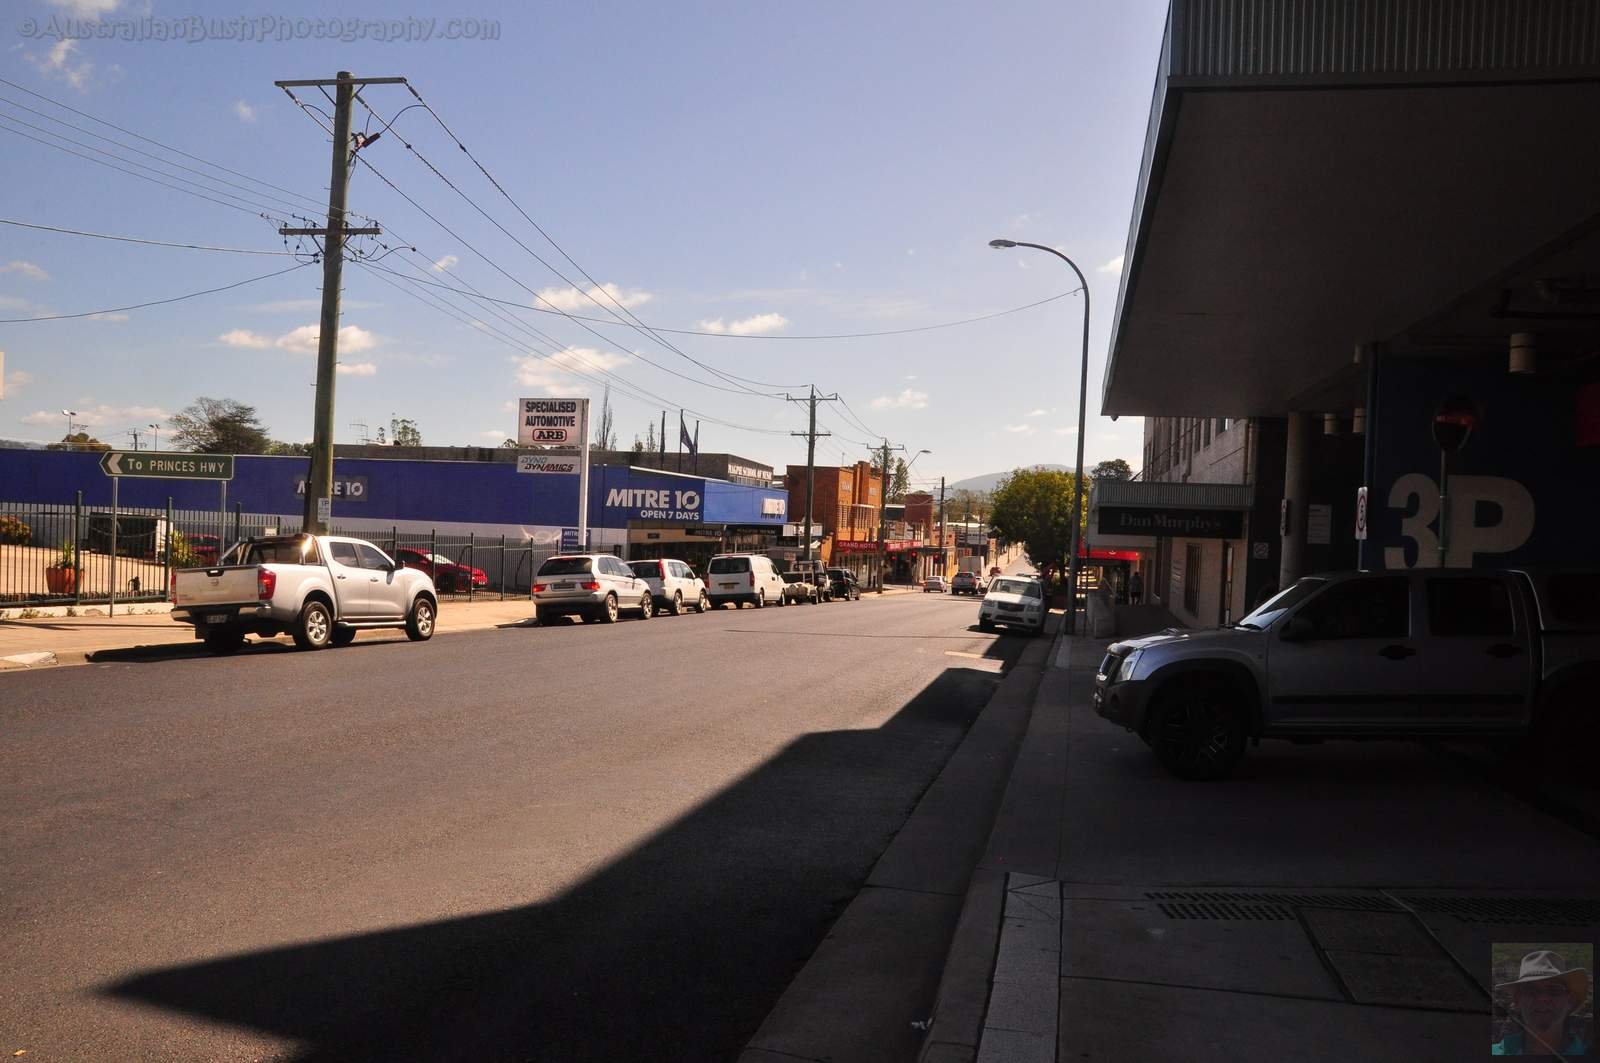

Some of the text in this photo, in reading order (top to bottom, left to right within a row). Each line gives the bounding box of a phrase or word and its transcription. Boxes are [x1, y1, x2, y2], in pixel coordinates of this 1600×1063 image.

[525, 401, 576, 413] SPECIALISED
[525, 415, 575, 427] AUTOMOTIVE
[536, 430, 564, 440] ARB
[127, 459, 225, 473] To PRINCES HWY
[521, 456, 547, 464] DYNO
[524, 463, 575, 473] DYNAMICS
[345, 481, 364, 496] 10
[605, 488, 700, 510] MITRE 10
[640, 510, 700, 520] OPEN 7 DAYS
[1119, 512, 1222, 533] Dan Murphy's
[1384, 473, 1536, 570] 3P
